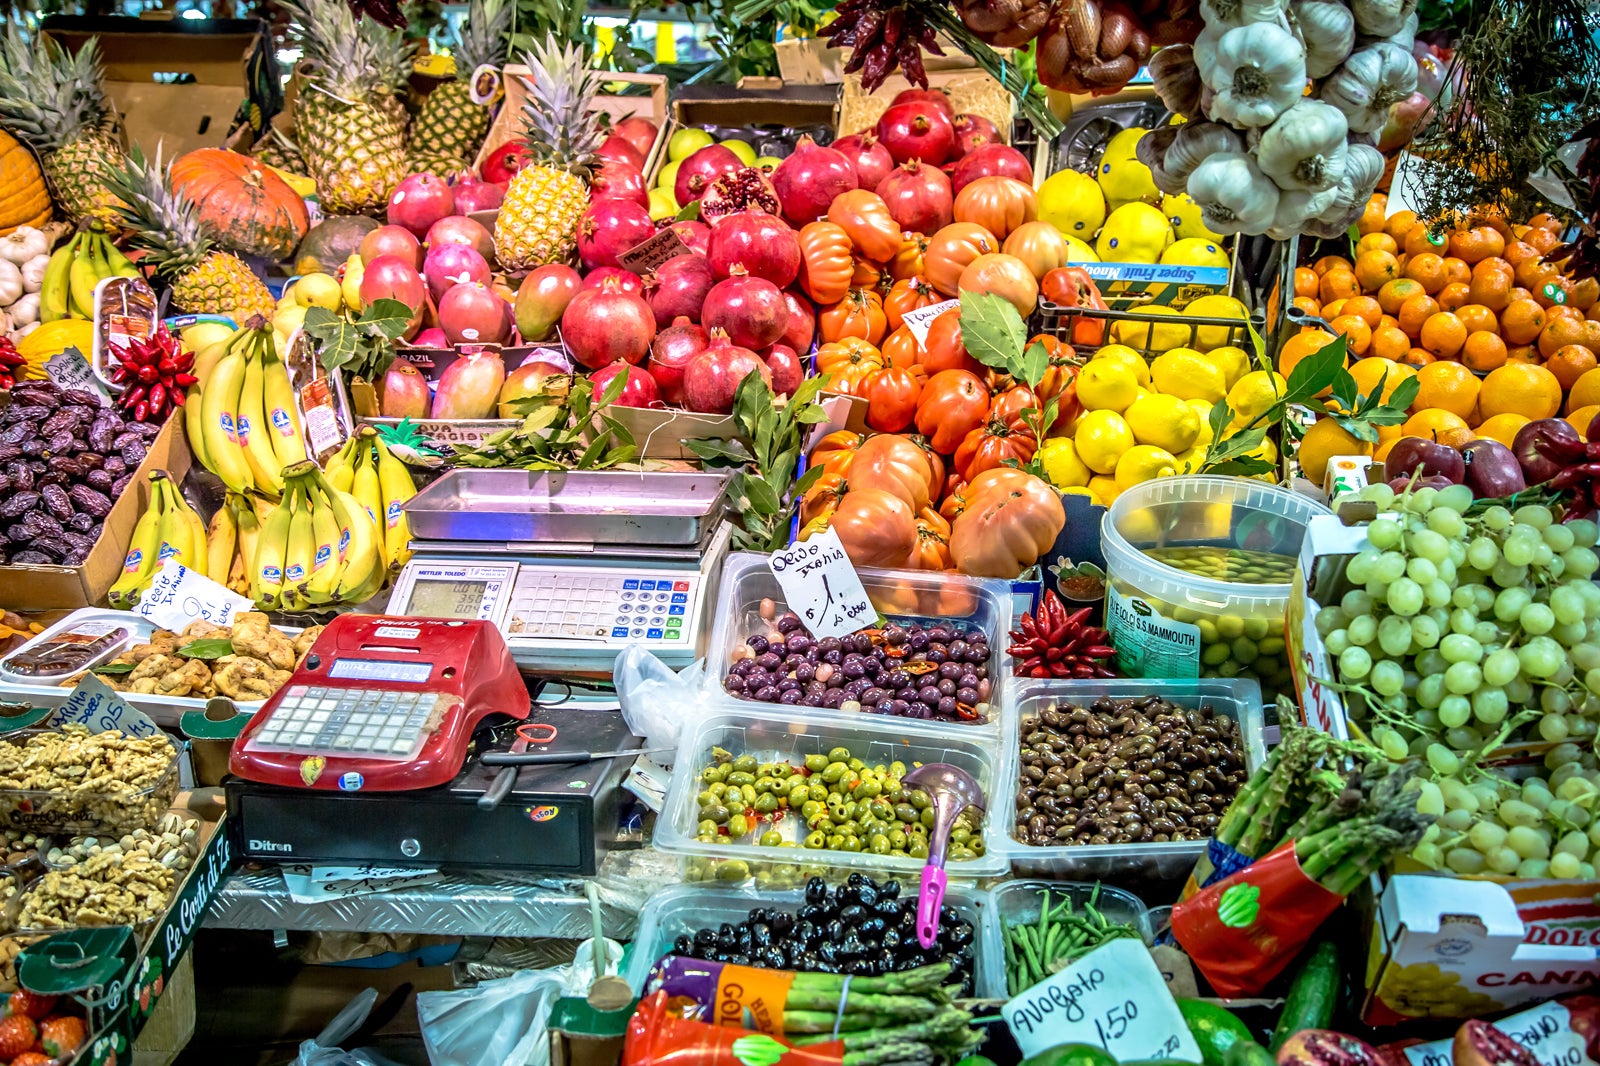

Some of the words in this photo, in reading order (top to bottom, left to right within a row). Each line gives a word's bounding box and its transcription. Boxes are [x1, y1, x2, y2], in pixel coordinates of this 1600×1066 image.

[1124, 266, 1153, 281] Fruit
[1157, 268, 1197, 282] Super
[487, 583, 499, 592] kg
[339, 662, 373, 670] TOTALE
[249, 839, 293, 852] Ditron
[166, 923, 183, 968] Le
[207, 853, 219, 893] di
